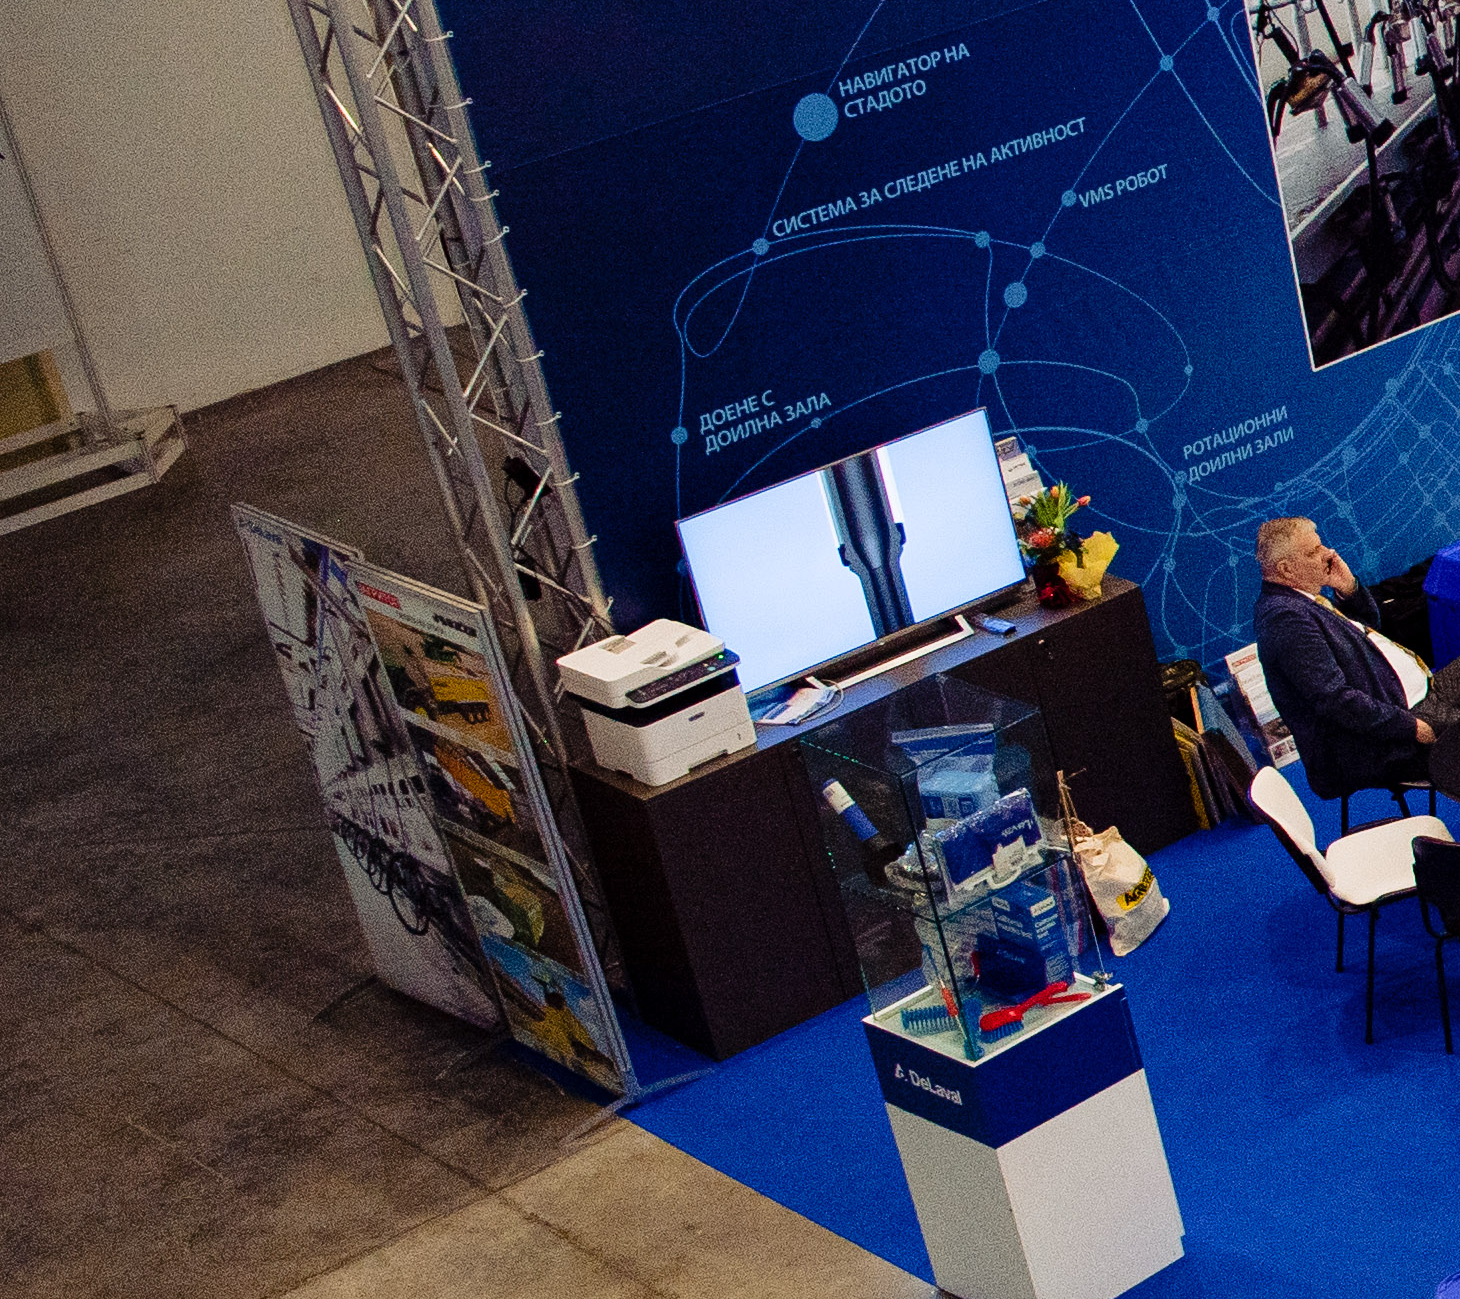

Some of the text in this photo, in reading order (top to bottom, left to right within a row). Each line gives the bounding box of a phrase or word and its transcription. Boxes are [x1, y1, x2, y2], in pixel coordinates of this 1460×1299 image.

[837, 42, 972, 98] НАВИГАТОР НА
[843, 78, 928, 120] СТАДОТО
[771, 115, 1088, 239] СИСТЕМА ЗА СЛЕДЕНЕ НА АКТИВНОСТ
[1077, 162, 1169, 211] VMS РОБОТ
[699, 388, 776, 438] ДОЕНЕ С
[703, 391, 833, 458] ДОИЛНА ЗАЛА
[1182, 404, 1289, 462] РОТАЦИОННИ
[1186, 424, 1296, 488] ДОИЛНИ ЗАЛИ
[908, 1068, 963, 1106] DeLaval
